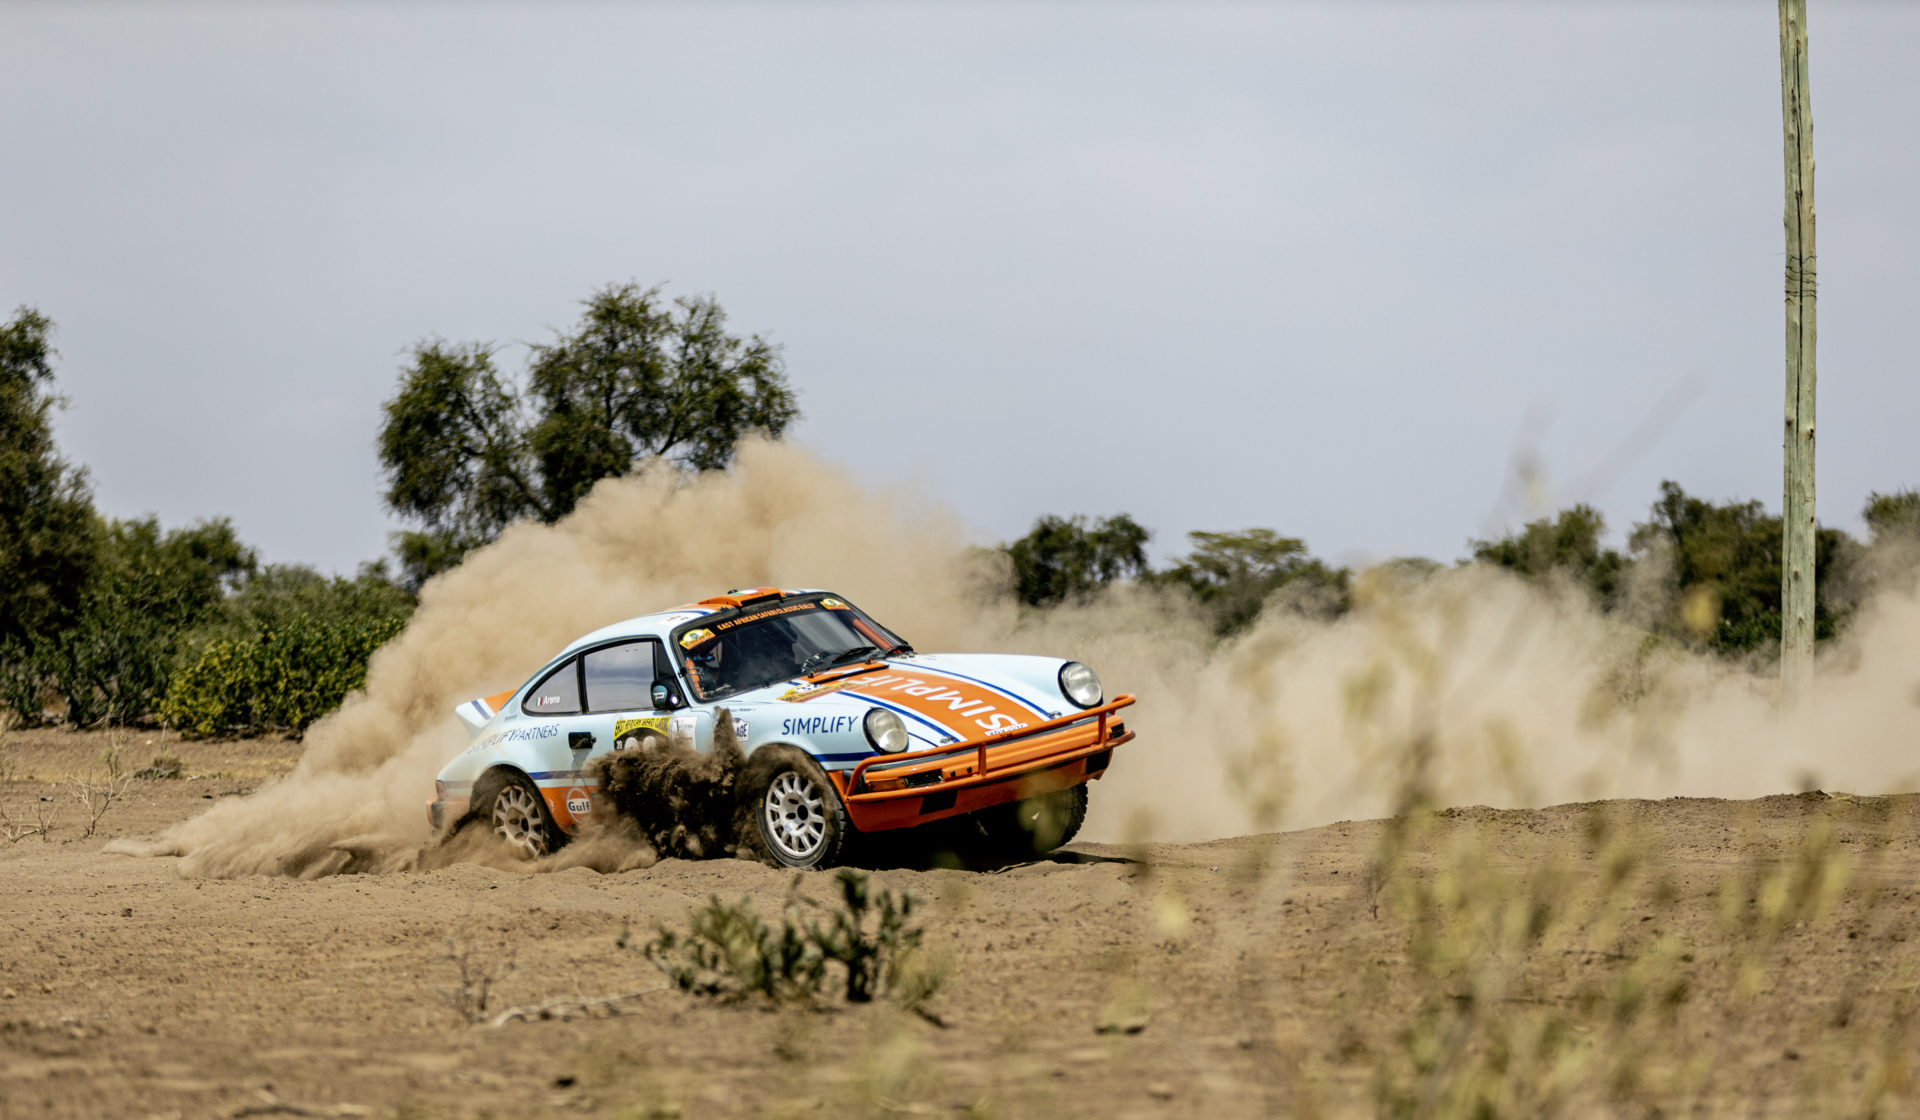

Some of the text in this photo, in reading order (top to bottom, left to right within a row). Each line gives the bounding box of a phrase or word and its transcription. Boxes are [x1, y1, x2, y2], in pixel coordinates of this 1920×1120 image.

[717, 621, 734, 631] EAST
[734, 614, 759, 625] AFRICAN
[758, 609, 778, 619] SAFARI
[777, 605, 801, 614] CLASSIC
[781, 715, 859, 736] SIMPLIFY
[567, 800, 591, 812] Gulf
